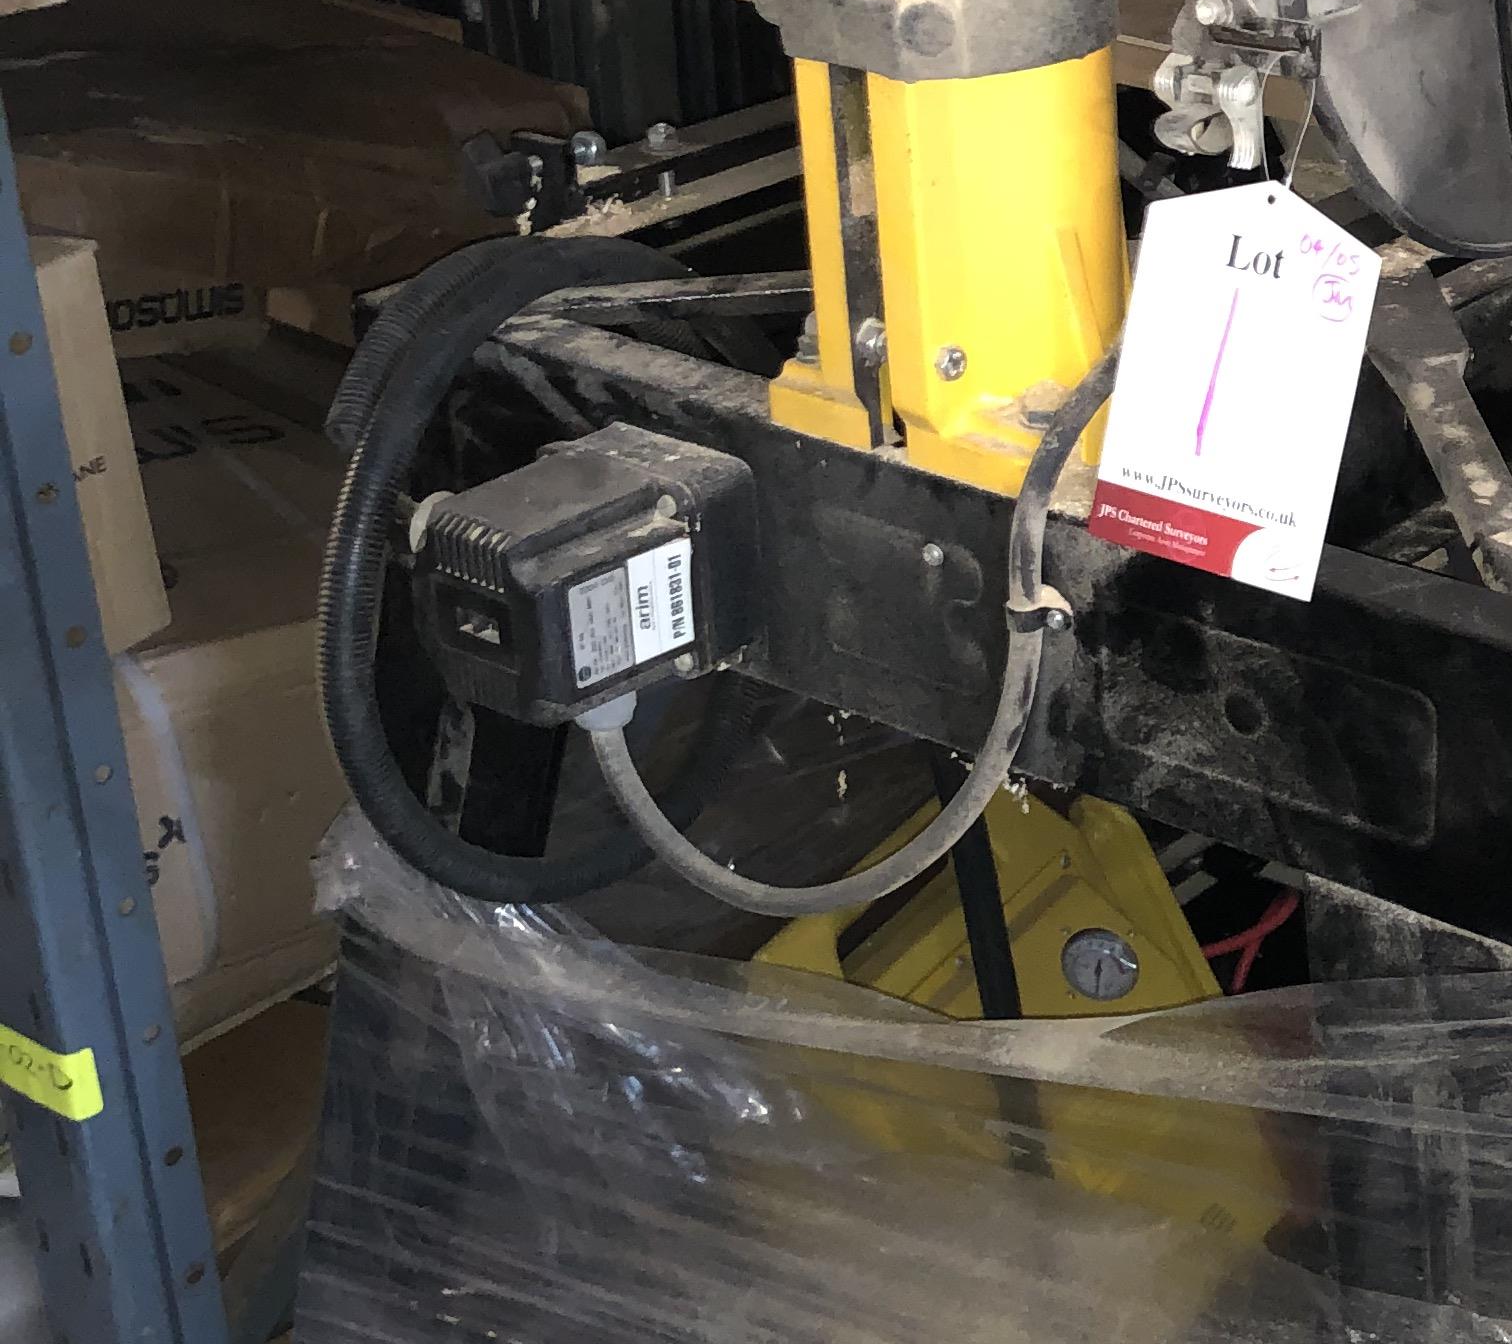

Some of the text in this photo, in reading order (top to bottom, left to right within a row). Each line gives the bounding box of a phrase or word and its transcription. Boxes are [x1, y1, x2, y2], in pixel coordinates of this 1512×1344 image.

[1225, 233, 1285, 280] Lot
[1121, 466, 1297, 528] www.JPSsurveyors.co.uk
[1098, 502, 1209, 547] JPS Chartered Surveyors
[671, 616, 687, 640] P/N
